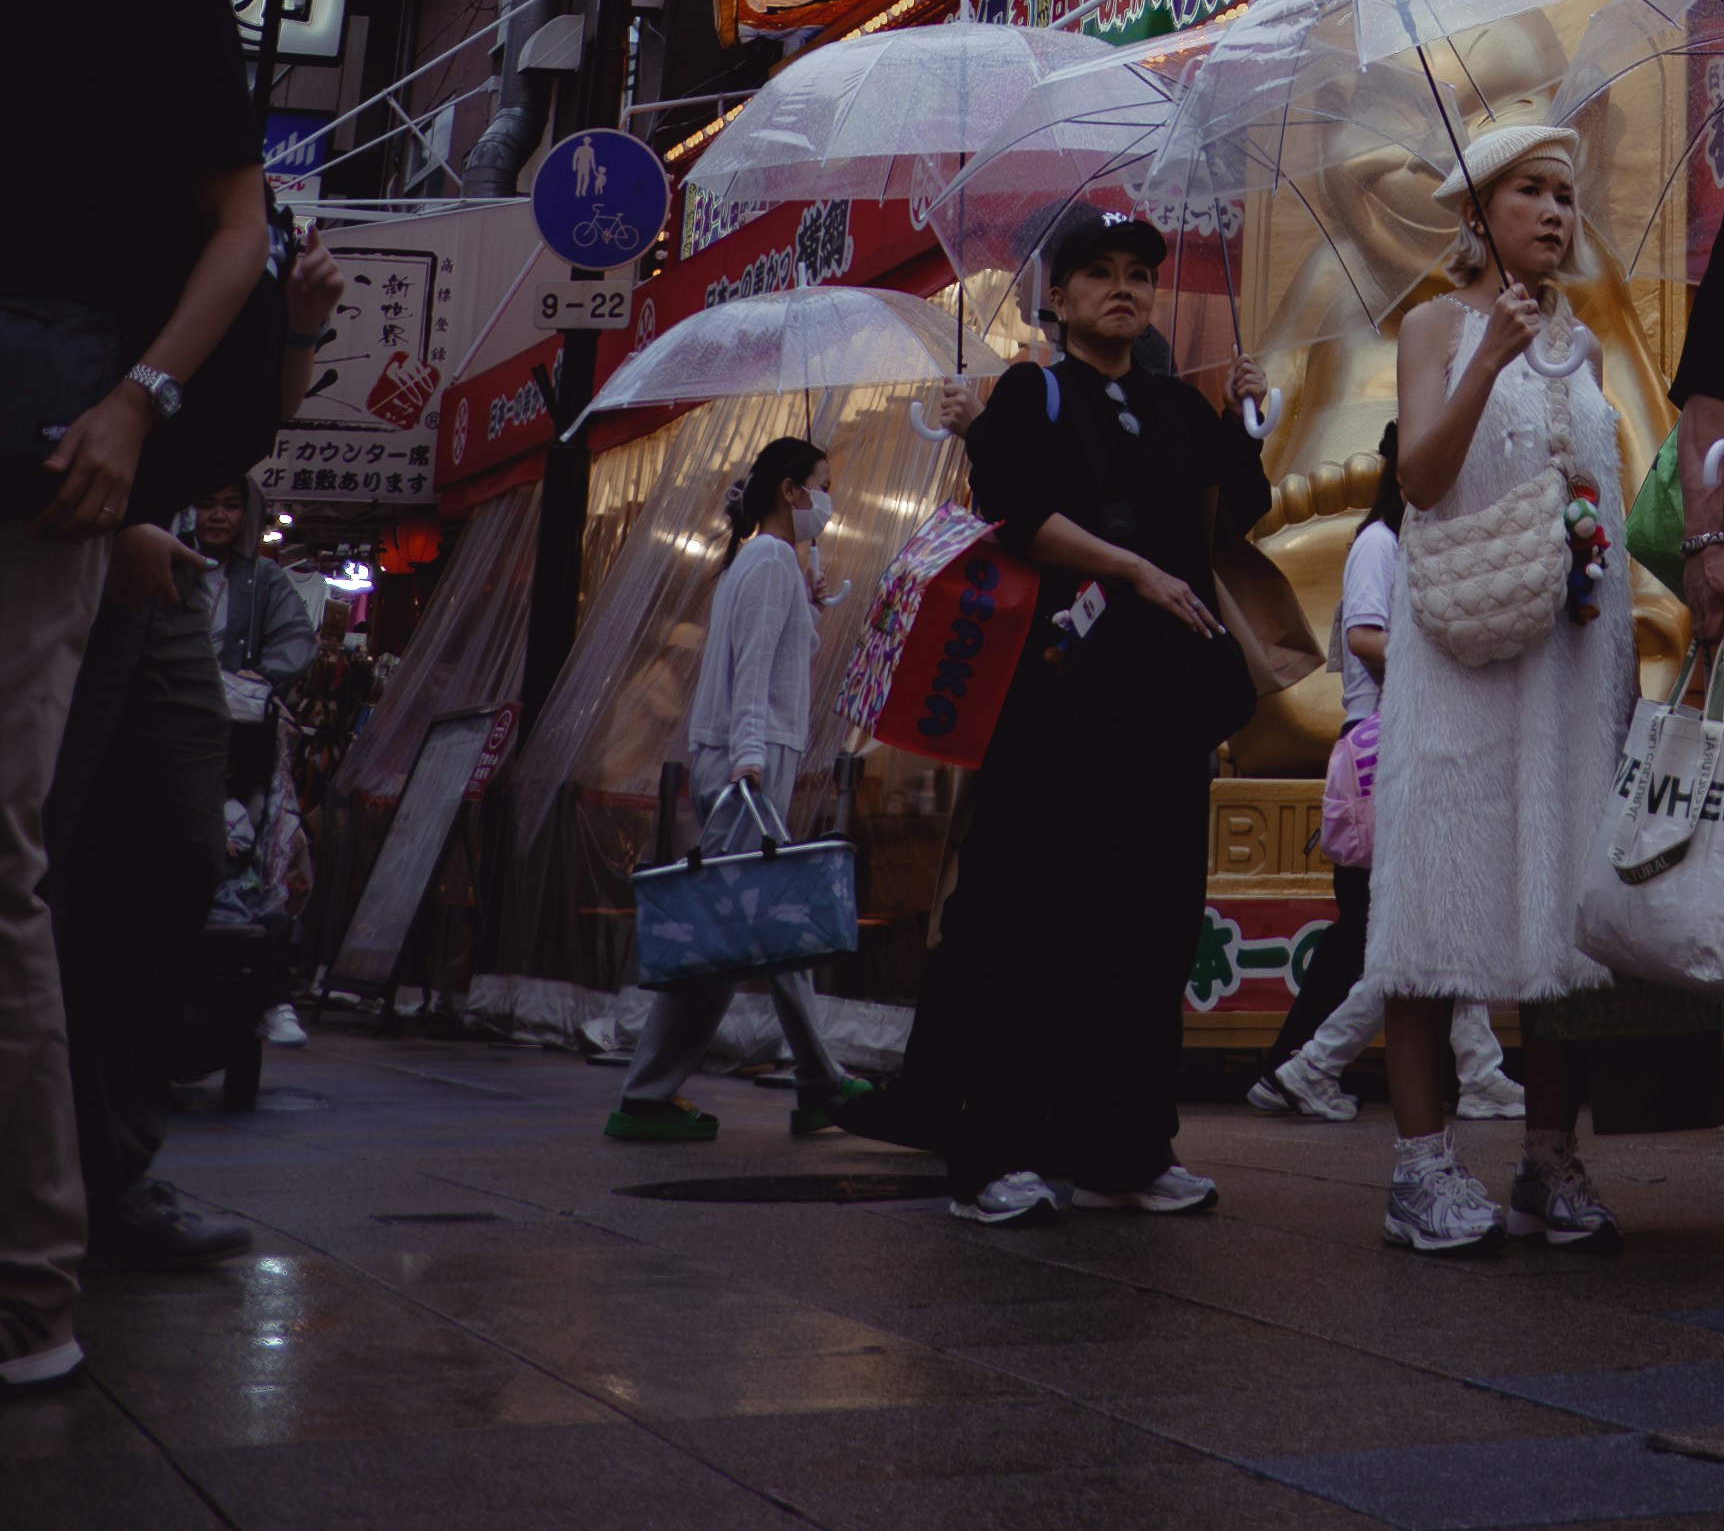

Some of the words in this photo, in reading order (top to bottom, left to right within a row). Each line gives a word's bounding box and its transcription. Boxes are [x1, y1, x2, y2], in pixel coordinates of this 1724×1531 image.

[380, 273, 415, 347] 新世界
[431, 257, 454, 362] 商標登録
[262, 468, 286, 489] 2F
[291, 469, 429, 494] 座敷あります
[295, 443, 432, 467] カウンター席
[917, 558, 1002, 737] OSAKA
